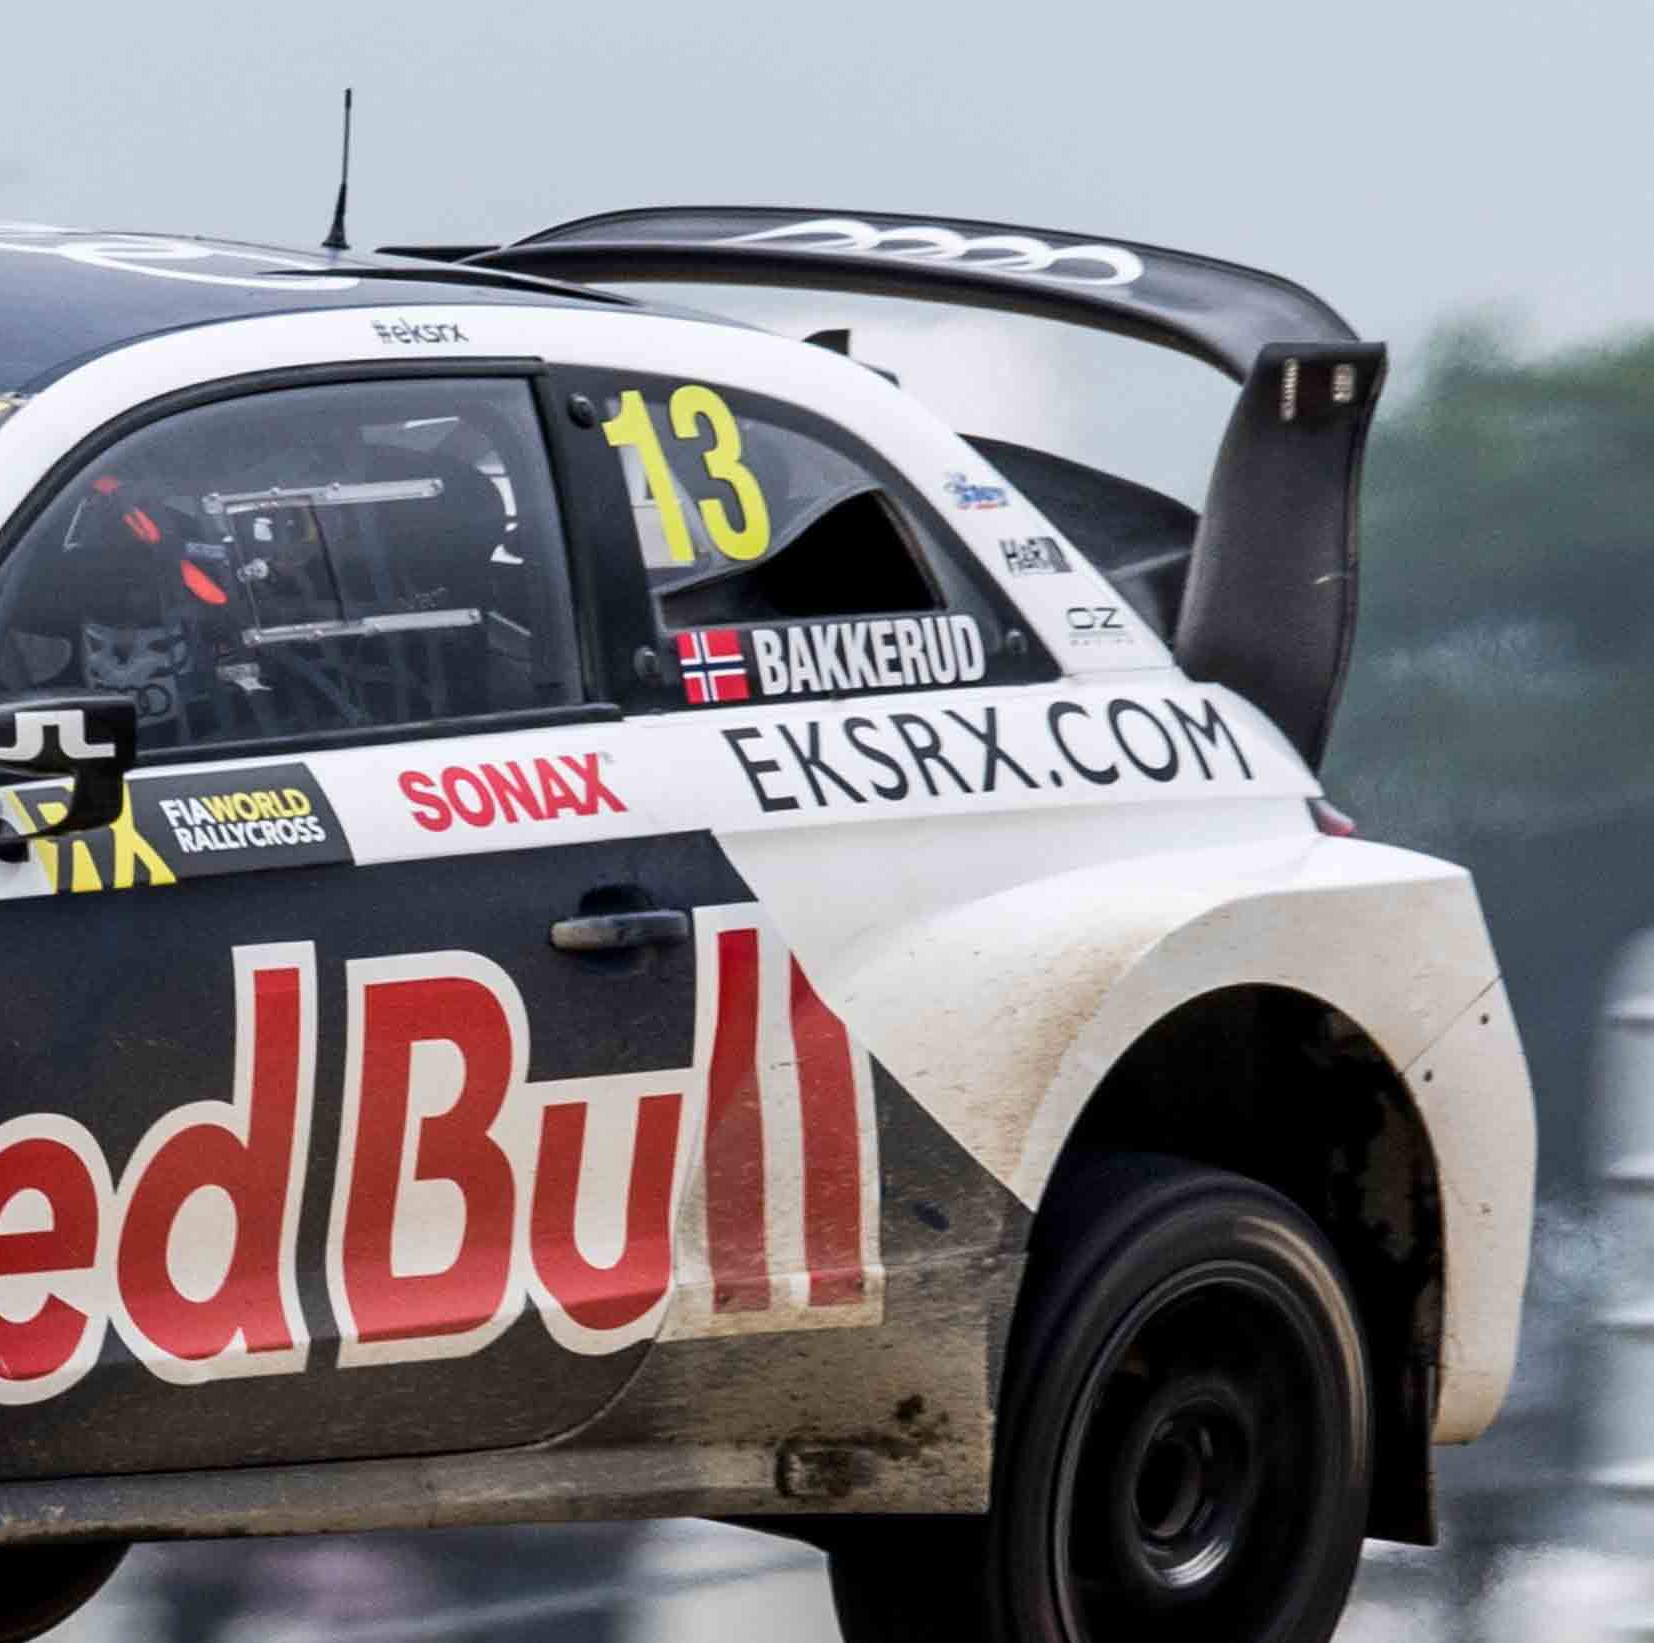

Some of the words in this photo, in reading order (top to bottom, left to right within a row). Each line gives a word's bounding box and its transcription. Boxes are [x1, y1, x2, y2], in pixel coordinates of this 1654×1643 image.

[601, 383, 771, 568] 13
[754, 613, 986, 697] BAKKERUD
[398, 751, 627, 833] SONAX
[724, 696, 1255, 815] EKSRX.COM
[172, 815, 328, 854] RALLYCROSS
[326, 902, 883, 1367] Bull
